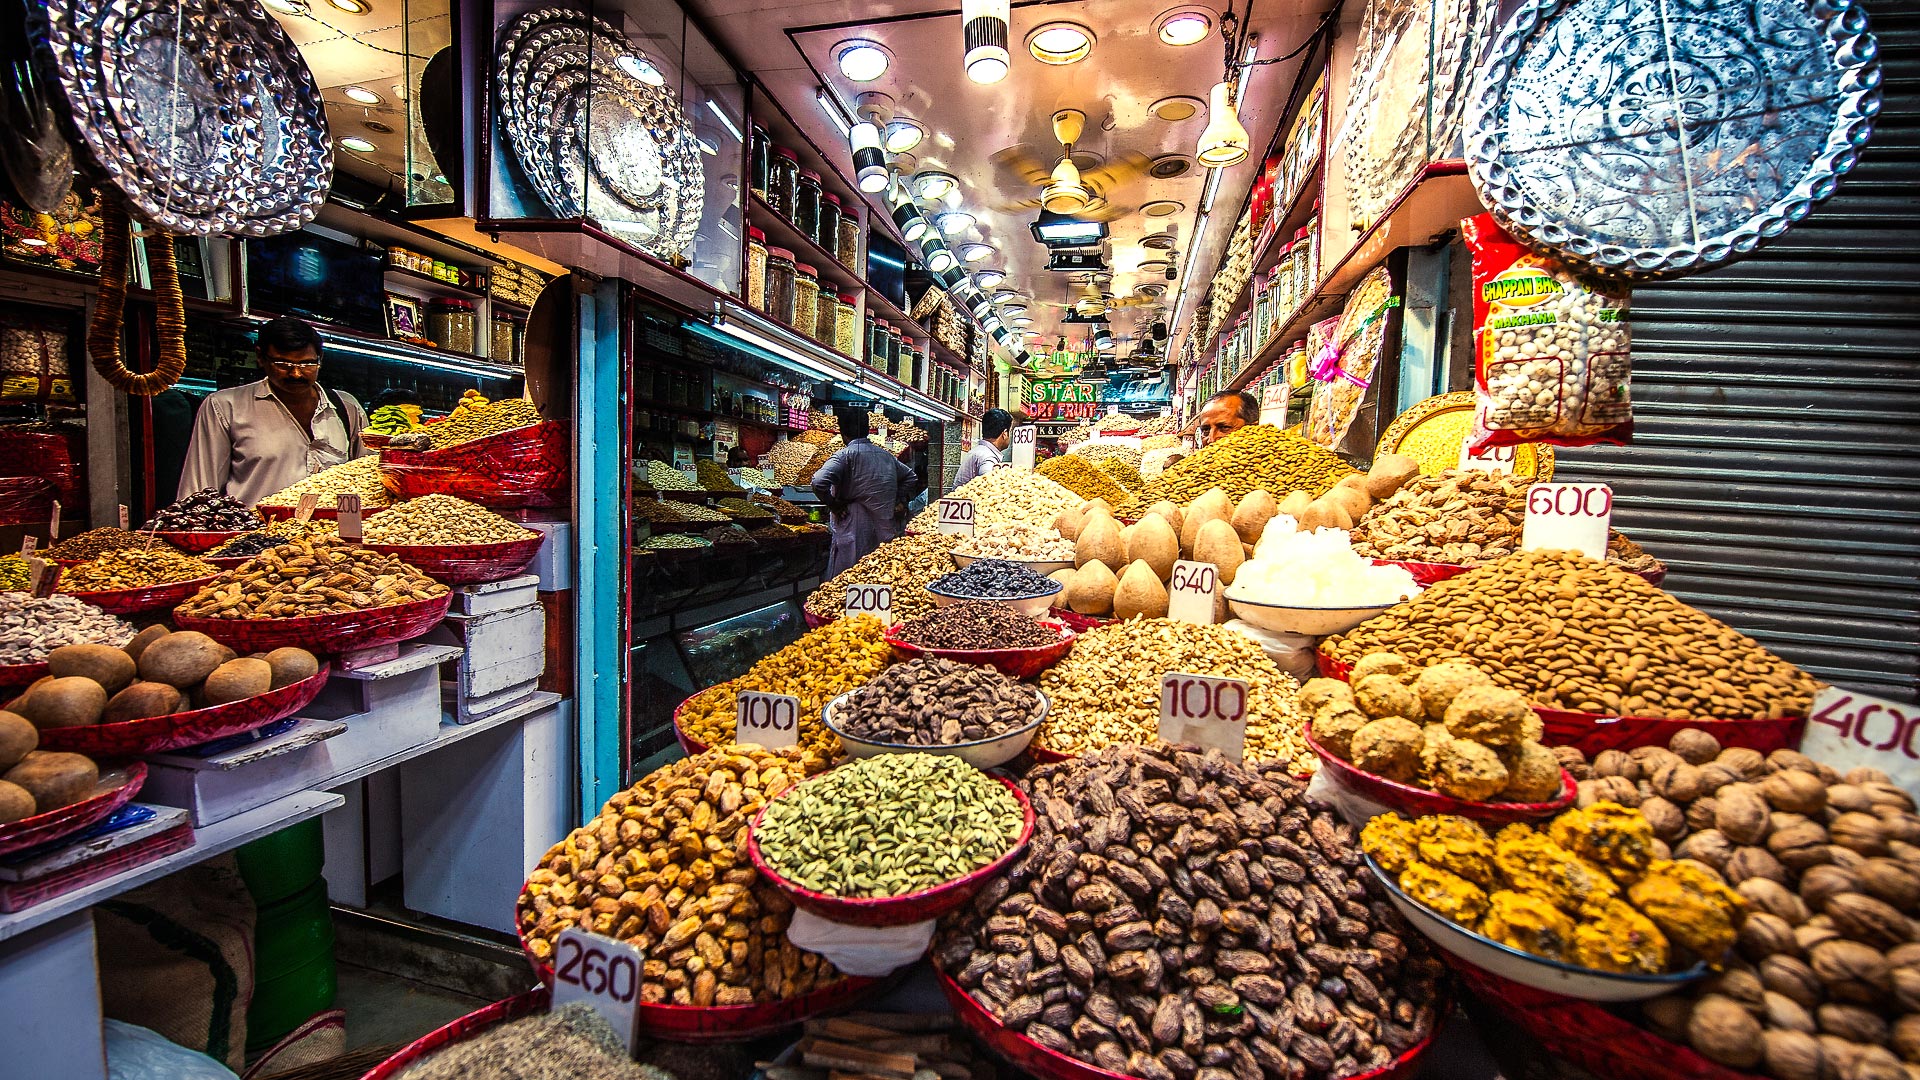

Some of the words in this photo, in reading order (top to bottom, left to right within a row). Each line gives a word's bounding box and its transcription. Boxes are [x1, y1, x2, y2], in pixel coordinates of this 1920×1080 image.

[1483, 277, 1534, 302] CHAPPAN
[1494, 312, 1556, 329] MAKHANA
[1033, 383, 1094, 402] STAR
[1263, 387, 1287, 406] 640
[1029, 403, 1054, 417] DRY
[1058, 402, 1096, 418] FRUIT
[1013, 428, 1034, 444] 860
[337, 496, 358, 513] 200
[940, 501, 973, 520] 720
[1529, 487, 1612, 517] 600
[1173, 565, 1215, 594] 640
[847, 587, 892, 611] 200
[1165, 679, 1245, 721] 100
[740, 695, 794, 731] 100
[557, 936, 637, 1004] 260
